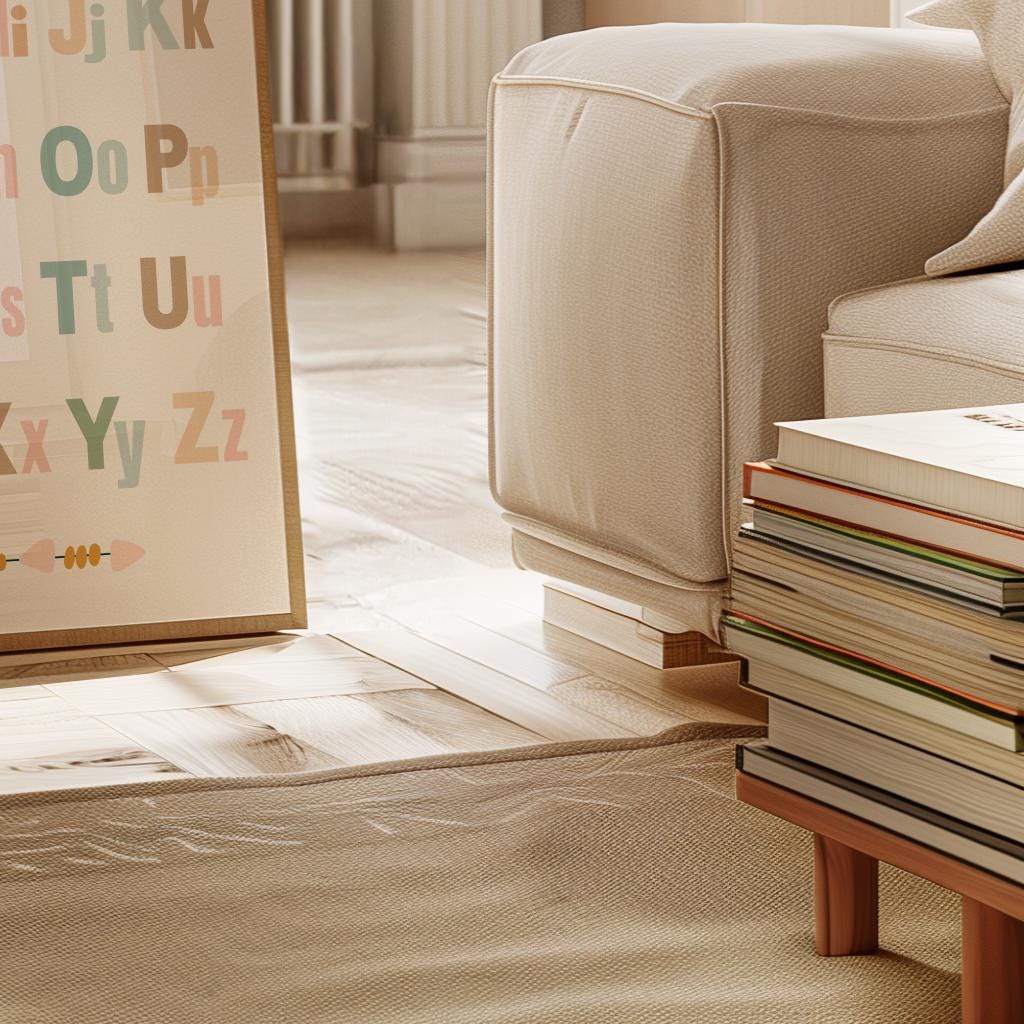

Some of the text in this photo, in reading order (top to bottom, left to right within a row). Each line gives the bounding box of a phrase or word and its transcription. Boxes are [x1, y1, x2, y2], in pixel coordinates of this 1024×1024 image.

[40, 125, 128, 196] Oo
[144, 124, 220, 206] Pp
[40, 260, 114, 334] Tt
[140, 256, 223, 329] Uu
[65, 396, 146, 488] Yy
[172, 391, 248, 464] Zz
